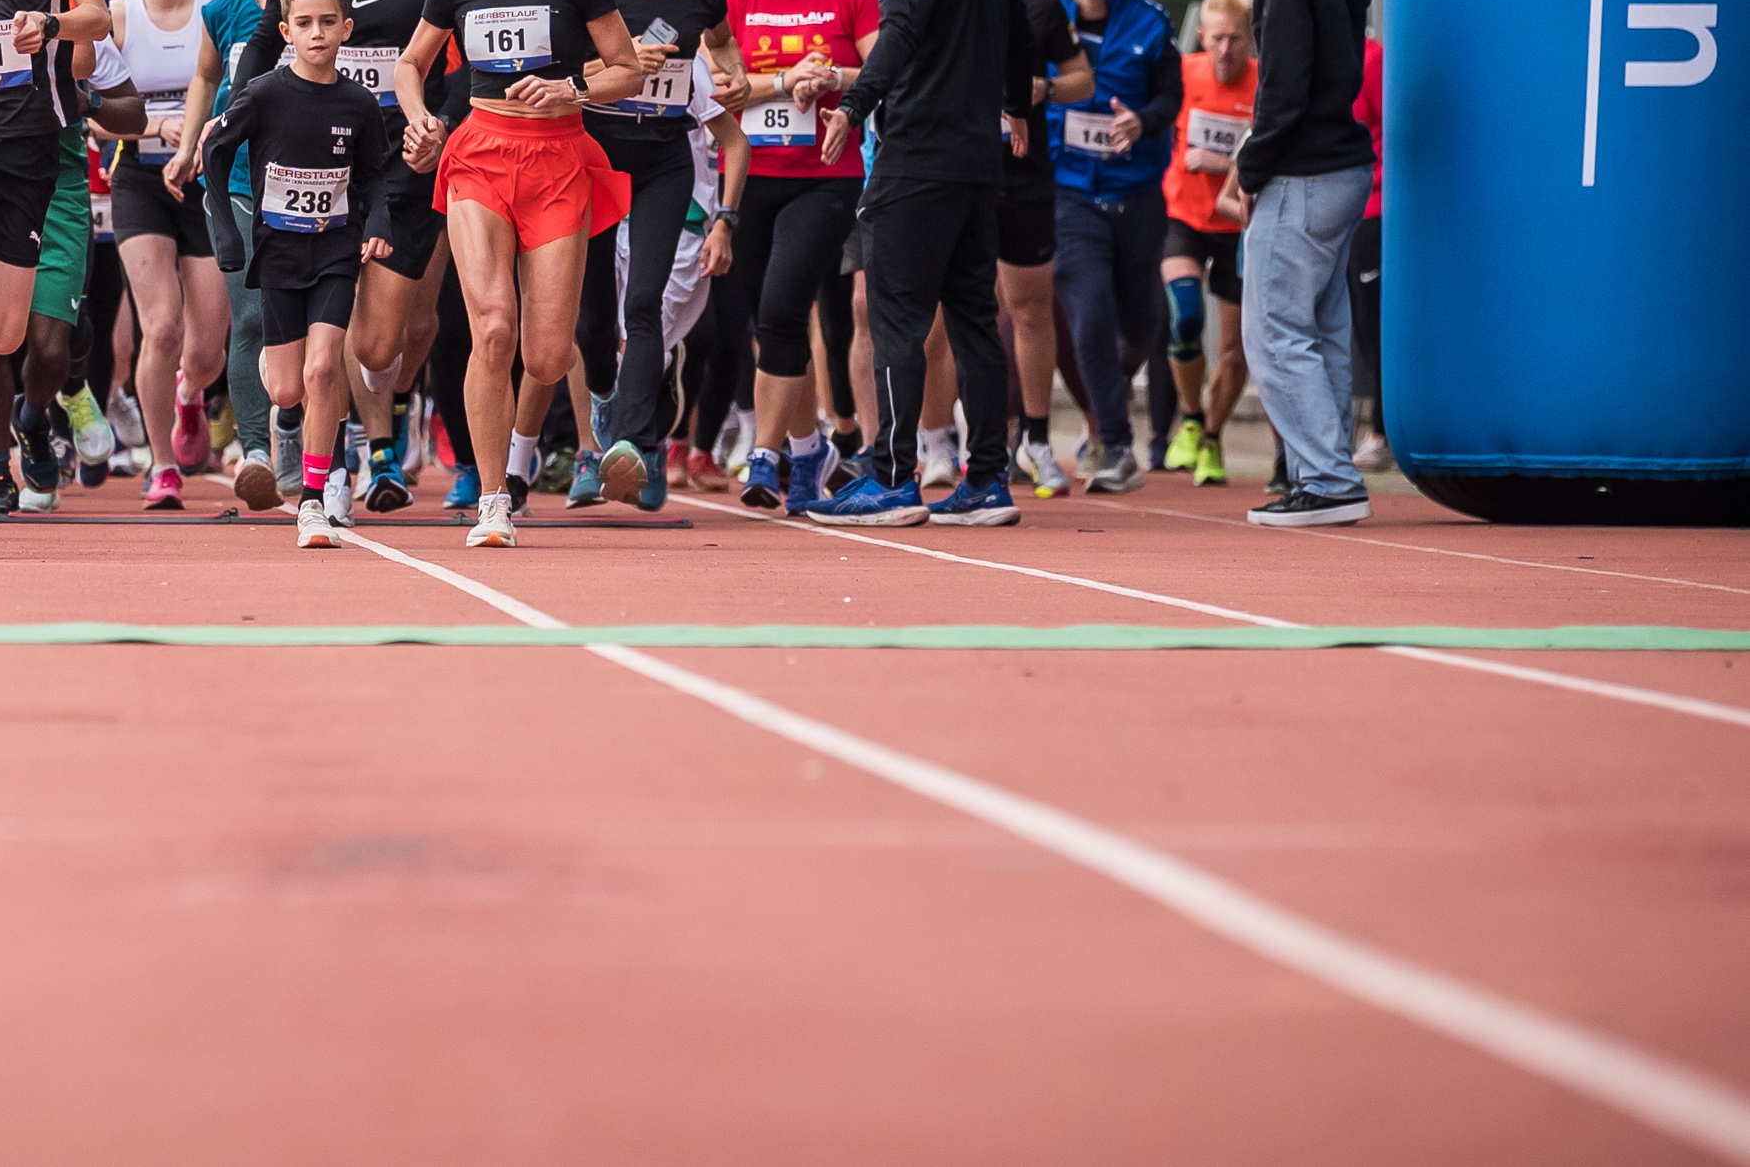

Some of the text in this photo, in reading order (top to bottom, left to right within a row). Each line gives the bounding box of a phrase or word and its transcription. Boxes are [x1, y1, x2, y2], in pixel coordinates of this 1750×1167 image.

[474, 10, 538, 20] HERBSTLAUF
[484, 28, 526, 54] 161
[764, 109, 790, 128] 85
[336, 136, 345, 146] &
[269, 166, 349, 180] HERBSTLAUF
[284, 189, 332, 214] 238
